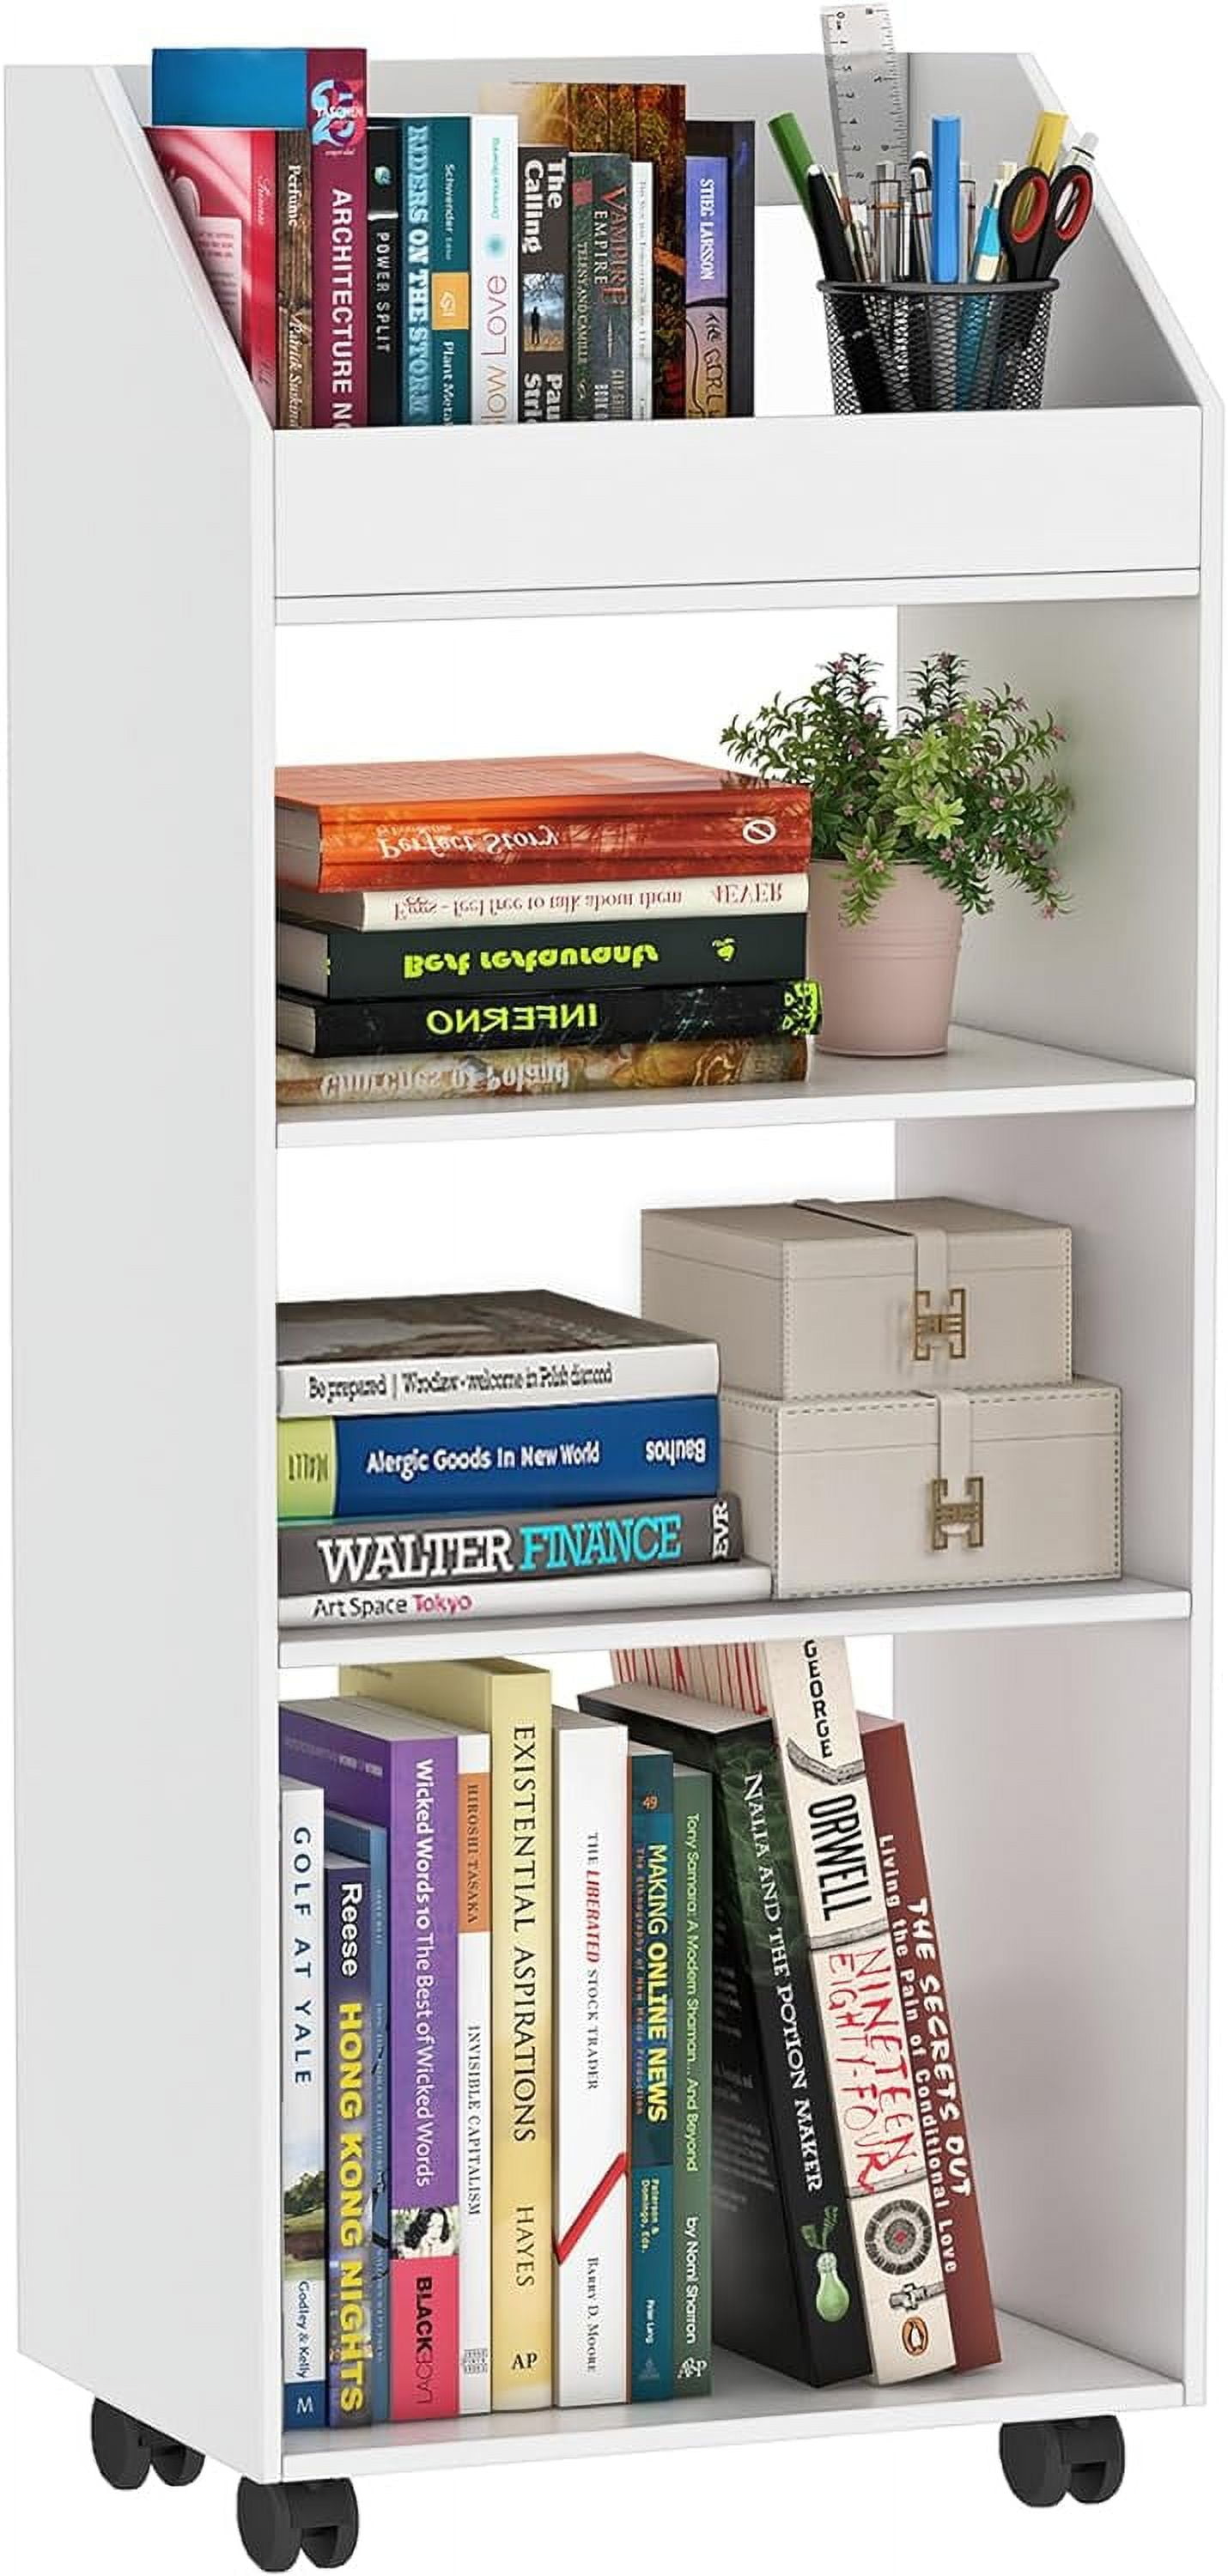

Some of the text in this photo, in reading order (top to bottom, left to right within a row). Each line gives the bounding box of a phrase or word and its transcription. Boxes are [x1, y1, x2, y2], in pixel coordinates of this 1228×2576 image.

[288, 163, 302, 227] Perfume
[443, 163, 455, 233] Schwender
[521, 160, 544, 254] Calling
[547, 158, 567, 210] The
[700, 178, 715, 281] STIEG LARSSON
[331, 188, 353, 394] ARCHITECTURE
[375, 231, 391, 354] POWER SPLIT
[408, 125, 429, 418] RIDERS ON THE STORM
[593, 210, 608, 285] EMPIRE
[599, 185, 629, 306] VAMPIRE
[442, 341, 455, 387] Plant
[480, 275, 508, 426] low Love
[367, 1440, 599, 1482] Alergic Goods In New World
[317, 1512, 683, 1584] WALTER FINANCE
[712, 1499, 729, 1560] EVR
[313, 1594, 473, 1619] Art Space Tokyo
[803, 1639, 833, 1759] GEORGE
[467, 1783, 479, 1924] HIROSHI TASAKA
[685, 1813, 701, 1848] Tony
[807, 1793, 872, 1922] ORWELL
[686, 1851, 700, 1918] Samara:
[686, 1920, 700, 1932] A
[293, 1826, 312, 2083] GOLF AT YALE
[416, 1759, 435, 2187] Wicked Words 10 The Best of Wicked Words
[586, 1831, 601, 2090] THE LIBERATED STOCK TRADER
[647, 1844, 668, 2123] MAKING ONLINE NEWS
[744, 1771, 824, 2192] NALIA AND THE POTION MAKER
[513, 1725, 537, 2287] EXISTENTIAL ASPIRATIONS HAYES
[878, 1834, 958, 2275] Living the Pain of Conditional Love
[908, 1897, 971, 2197] THE SECRETS OUT
[686, 2078, 700, 2110] And
[828, 1953, 888, 2193] EIGHTY-FOUR
[854, 1947, 917, 2169] NINETEEN
[339, 1882, 364, 2412] Reese HONG KONG NIGHTS
[467, 2026, 482, 2215] INVISIBLE CAPITALISM
[684, 2113, 700, 2172] Beyond
[684, 2215, 699, 2238] by
[686, 2240, 700, 2281] Nomi
[296, 2281, 310, 2379] Godley & Kelly
[416, 2276, 433, 2353] BLACK
[511, 2352, 538, 2371] AP
[645, 2322, 656, 2344] Lang
[686, 2284, 700, 2345] Sharron
